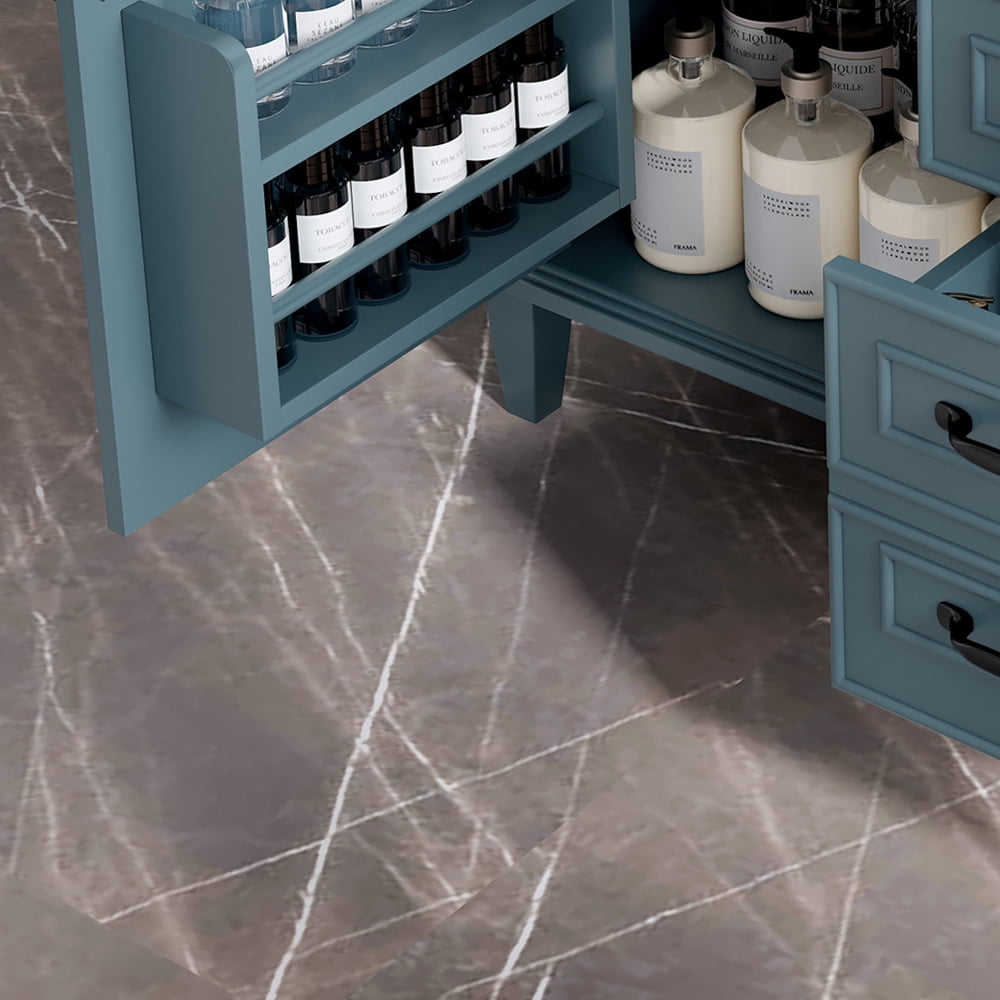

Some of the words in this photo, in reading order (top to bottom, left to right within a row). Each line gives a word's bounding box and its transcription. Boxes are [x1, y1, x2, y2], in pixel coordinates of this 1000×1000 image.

[742, 31, 785, 47] LIQUID
[831, 63, 876, 76] IQUIDE
[832, 82, 864, 91] SEILLE
[673, 243, 698, 251] FRAMA
[789, 288, 814, 296] FRAMA
